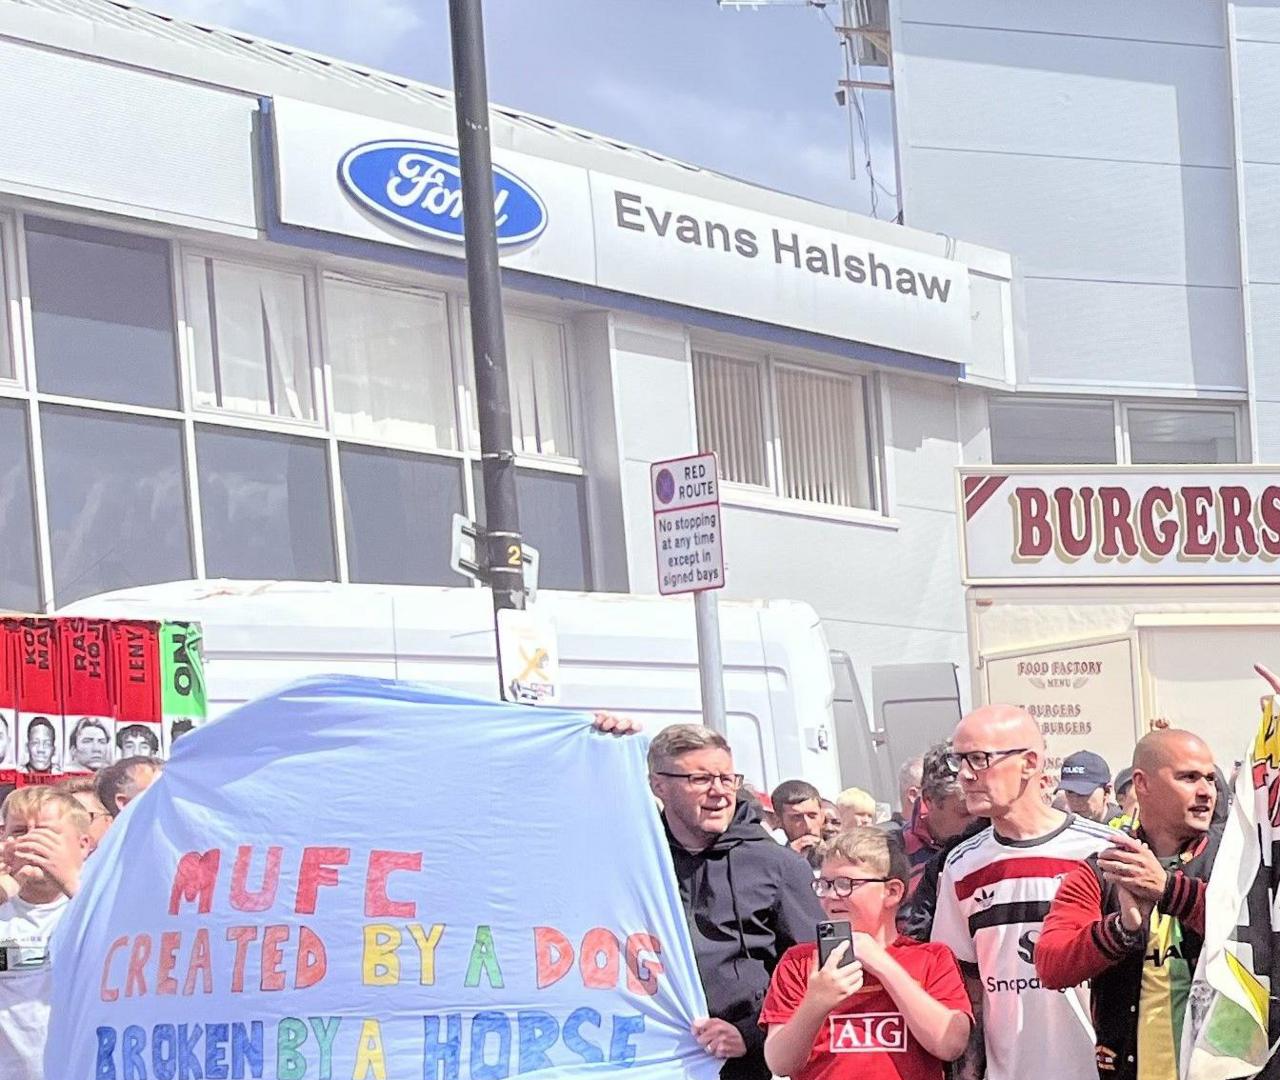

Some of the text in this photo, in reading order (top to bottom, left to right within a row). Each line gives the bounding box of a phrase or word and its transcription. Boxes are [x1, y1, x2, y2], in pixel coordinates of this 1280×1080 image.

[614, 190, 952, 303] Evans Halshaw
[684, 464, 706, 480] RED
[678, 481, 715, 499] ROUTE
[659, 514, 716, 533] No stopping
[662, 532, 715, 550] at any time
[507, 545, 521, 565] 2
[668, 550, 711, 567] except in
[664, 567, 719, 587] signed bays
[127, 628, 145, 683] LENY
[171, 621, 193, 696] ON
[1017, 661, 1103, 676] FOOD FACTORY
[1047, 679, 1071, 688] MENU
[1027, 704, 1081, 718] BURGERS
[1042, 722, 1092, 735] BURGERS
[167, 844, 424, 919] MUFC
[99, 923, 667, 1003] CREATED BY A DOG
[835, 1017, 902, 1047] AIG
